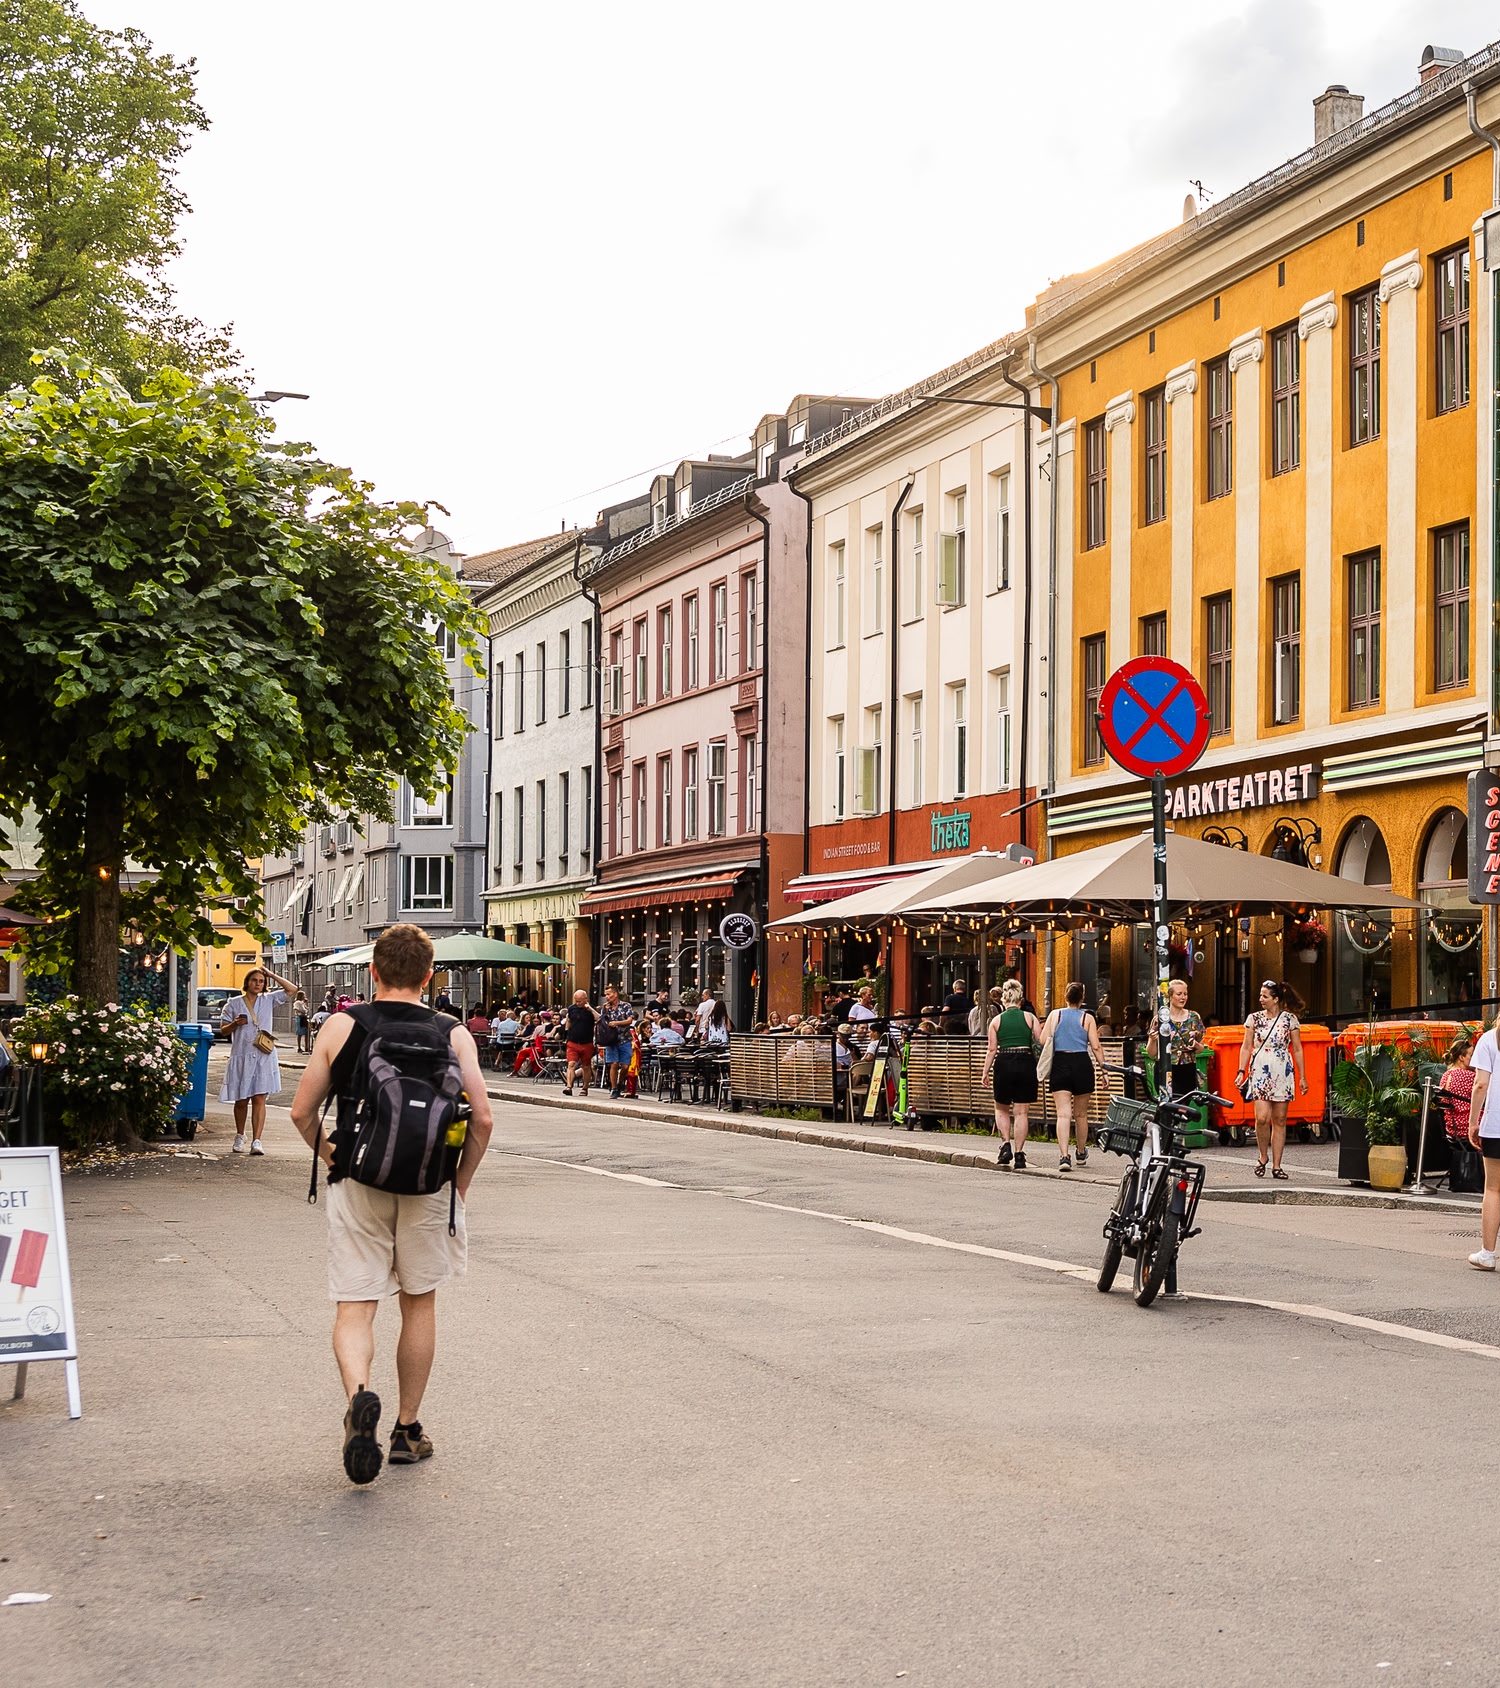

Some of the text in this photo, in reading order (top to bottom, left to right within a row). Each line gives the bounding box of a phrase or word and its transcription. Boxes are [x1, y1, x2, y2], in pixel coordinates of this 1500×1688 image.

[823, 847, 838, 860] INDIAN
[838, 845, 854, 858] STREET
[854, 844, 867, 856] FOOD
[871, 841, 880, 854] BAR
[498, 901, 523, 922] VILLA
